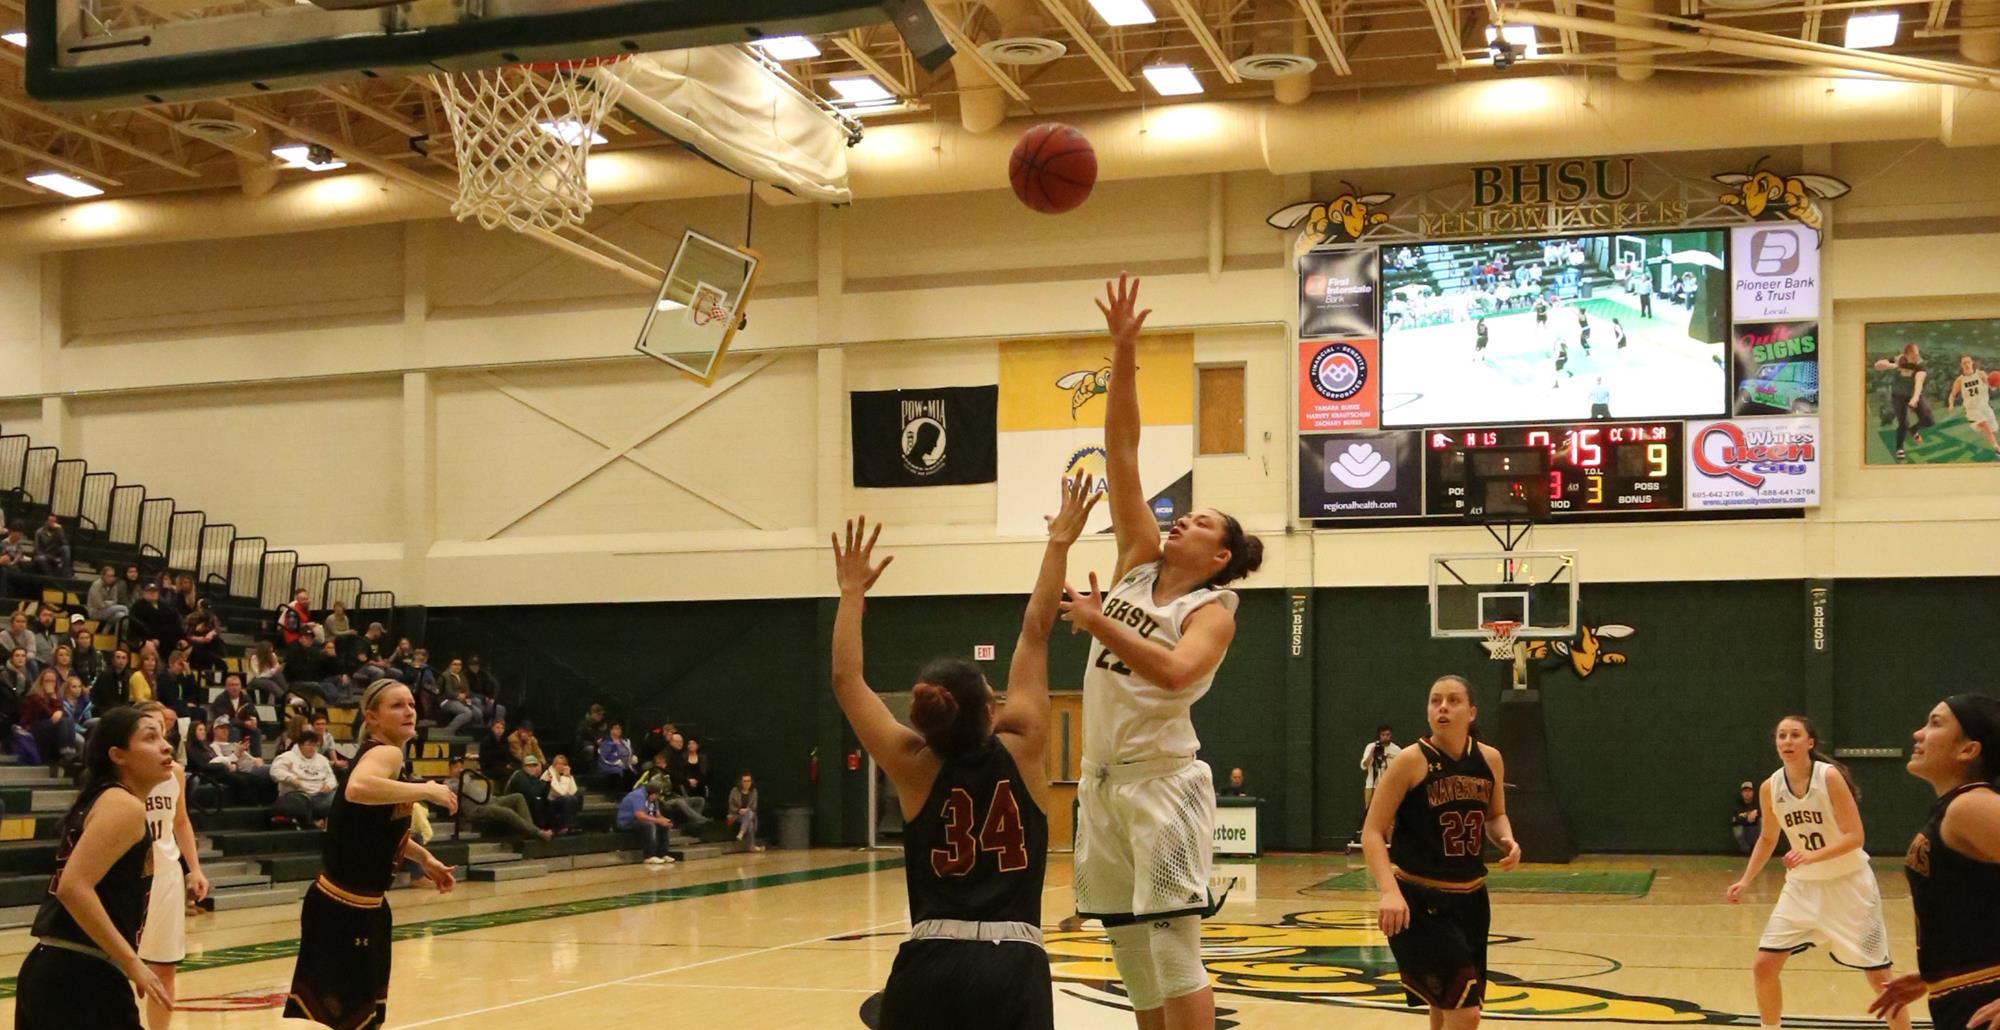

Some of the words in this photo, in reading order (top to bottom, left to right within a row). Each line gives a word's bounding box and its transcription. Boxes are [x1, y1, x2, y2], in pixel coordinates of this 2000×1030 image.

[1471, 158, 1635, 208] BHSU
[1328, 278, 1350, 287] First
[1736, 279, 1782, 291] Pioneer
[1785, 277, 1814, 289] Bank
[1755, 291, 1763, 301] &
[1768, 289, 1796, 301] Trust
[1312, 346, 1335, 376] FINANCIAL
[1342, 346, 1366, 371] BENEFITS
[1752, 335, 1816, 363] SIGNS
[901, 400, 923, 430] POW
[1648, 443, 1668, 477] 9
[1692, 422, 1815, 489] Queen
[1587, 475, 1602, 503] 3
[1618, 495, 1652, 505] BONUS
[1634, 482, 1660, 491] POSS
[1323, 501, 1398, 512] regionalhealth.com
[1104, 597, 1160, 640] BHSU
[1813, 606, 1825, 650] BHSU
[1291, 614, 1303, 656] BHSU
[977, 647, 992, 659] EXIT
[145, 796, 173, 812] HSU
[931, 779, 1028, 878] 34
[1440, 810, 1485, 856] 23
[1784, 810, 1824, 828] BHSU
